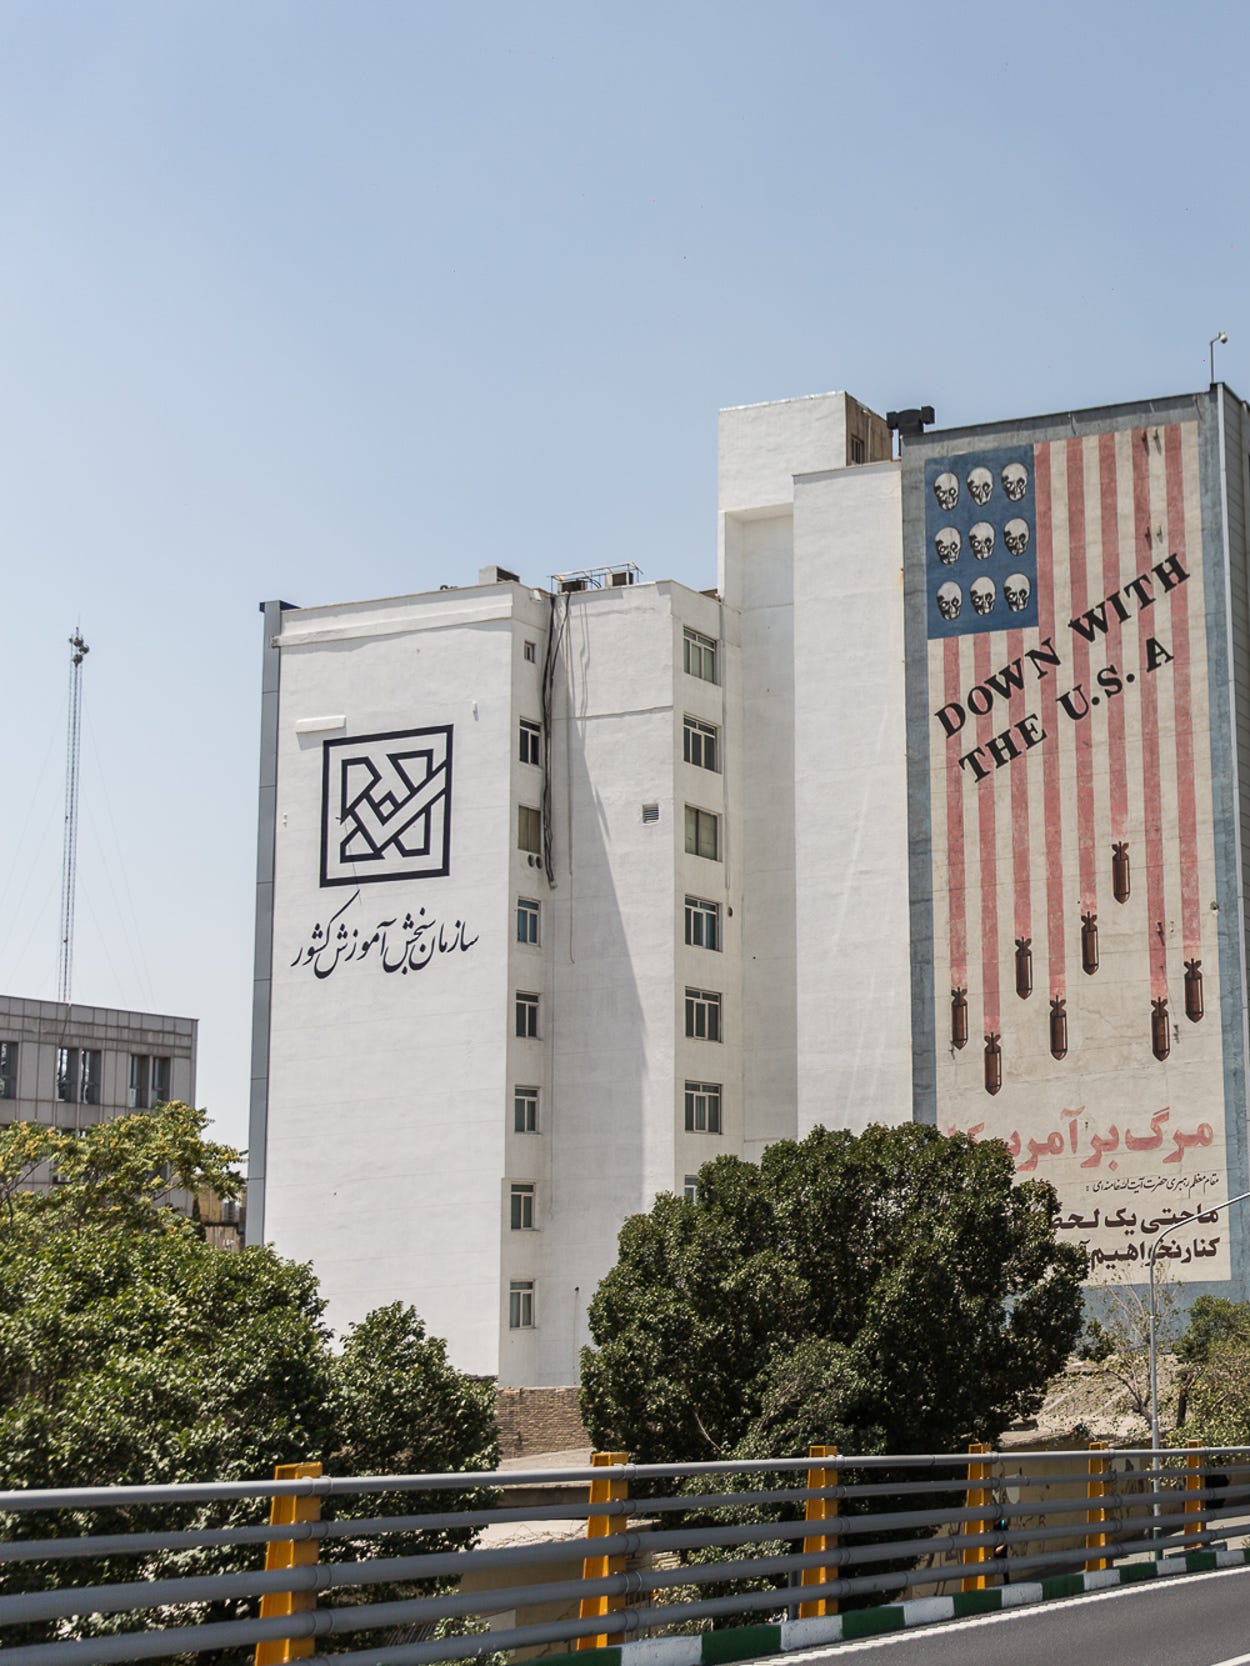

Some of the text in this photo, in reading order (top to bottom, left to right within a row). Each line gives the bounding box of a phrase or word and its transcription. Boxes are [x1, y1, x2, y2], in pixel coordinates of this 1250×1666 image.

[934, 553, 1191, 740] DOWN WITH
[958, 713, 1048, 784] THE
[290, 888, 480, 979] سازمان سنجش آموزش کشور
[1080, 1124, 1120, 1172] بر
[1124, 1106, 1214, 1164] مرگ
[1143, 1175, 1168, 1193] حضرت
[1166, 1177, 1189, 1192] رهبری
[1188, 1173, 1206, 1200] معظم
[1203, 1173, 1220, 1195] مقام
[1104, 1208, 1137, 1236] یک
[1140, 1208, 1194, 1234] حتی
[1197, 1203, 1219, 1224] ما
[1090, 1237, 1182, 1272] نخواهیم
[1180, 1237, 1221, 1264] کنار
